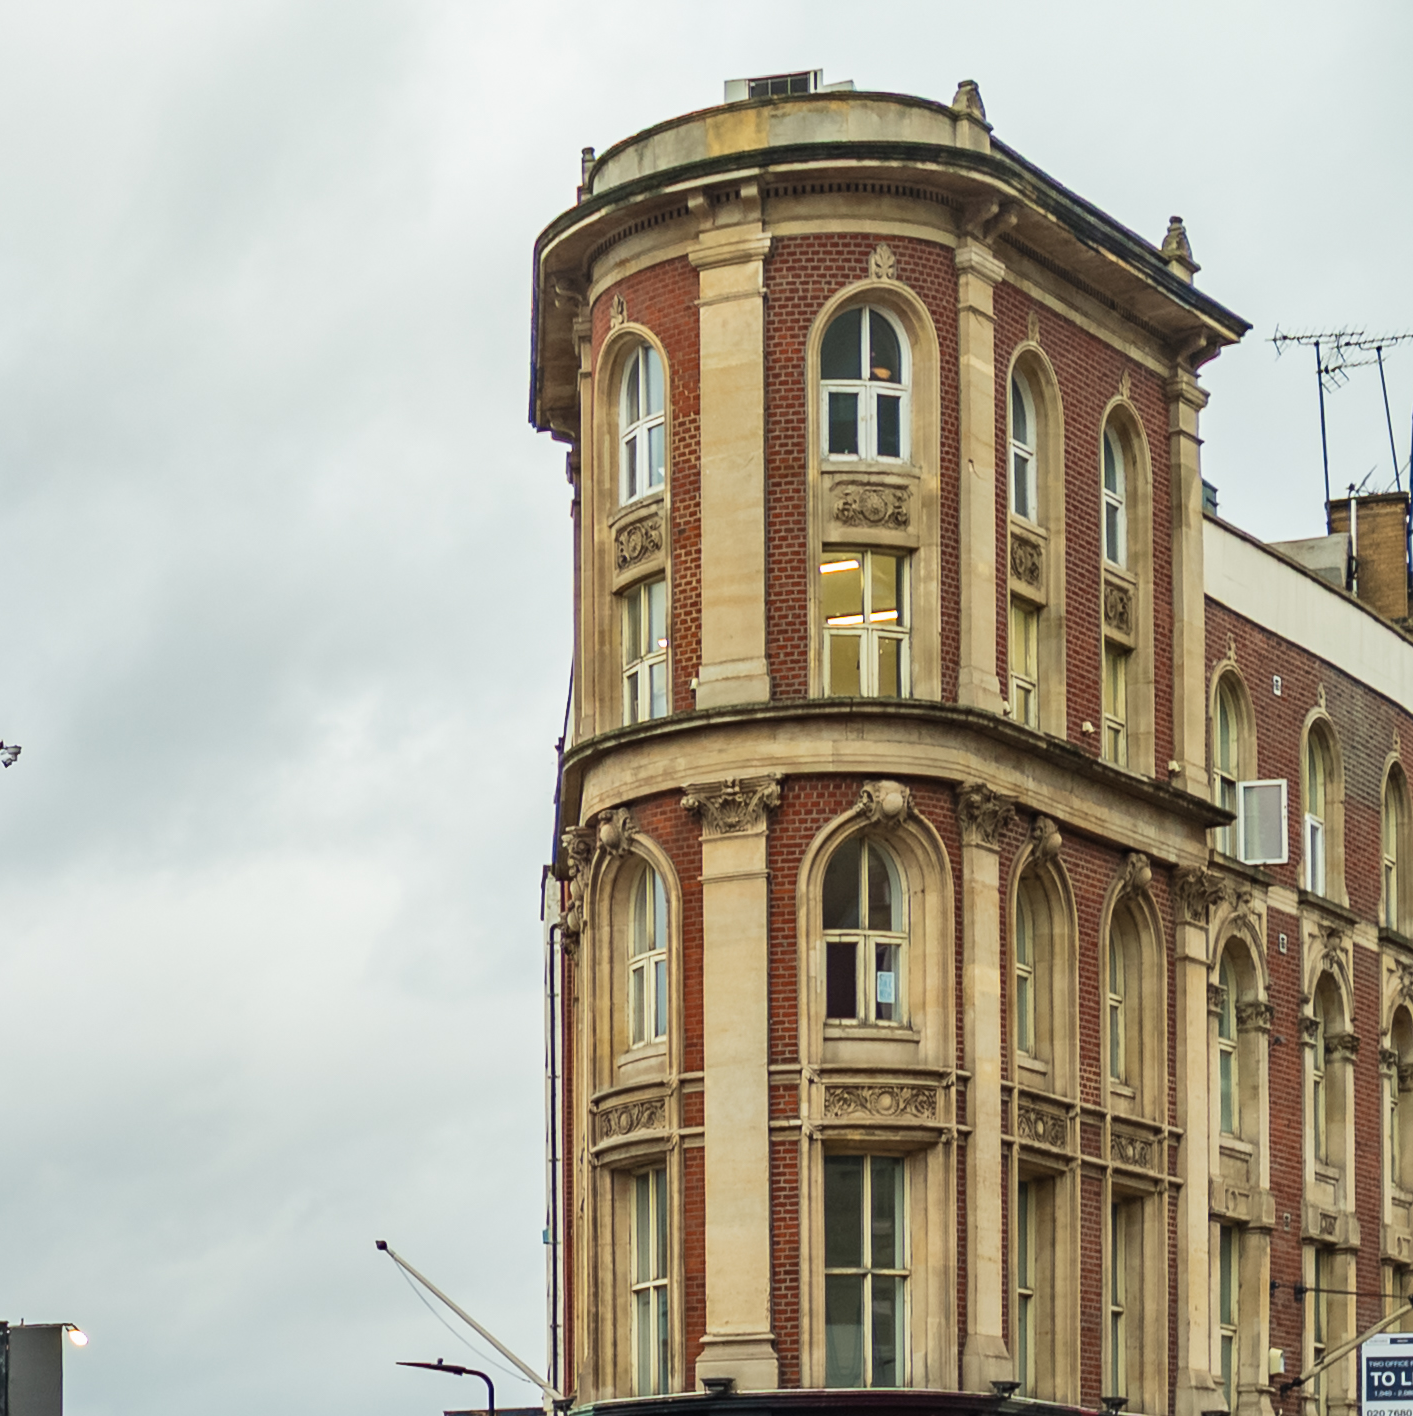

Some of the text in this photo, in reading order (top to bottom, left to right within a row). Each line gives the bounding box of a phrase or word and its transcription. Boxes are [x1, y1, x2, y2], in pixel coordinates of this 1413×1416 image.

[1385, 1360, 1409, 1368] OFFICE
[1370, 1371, 1413, 1387] TO L
